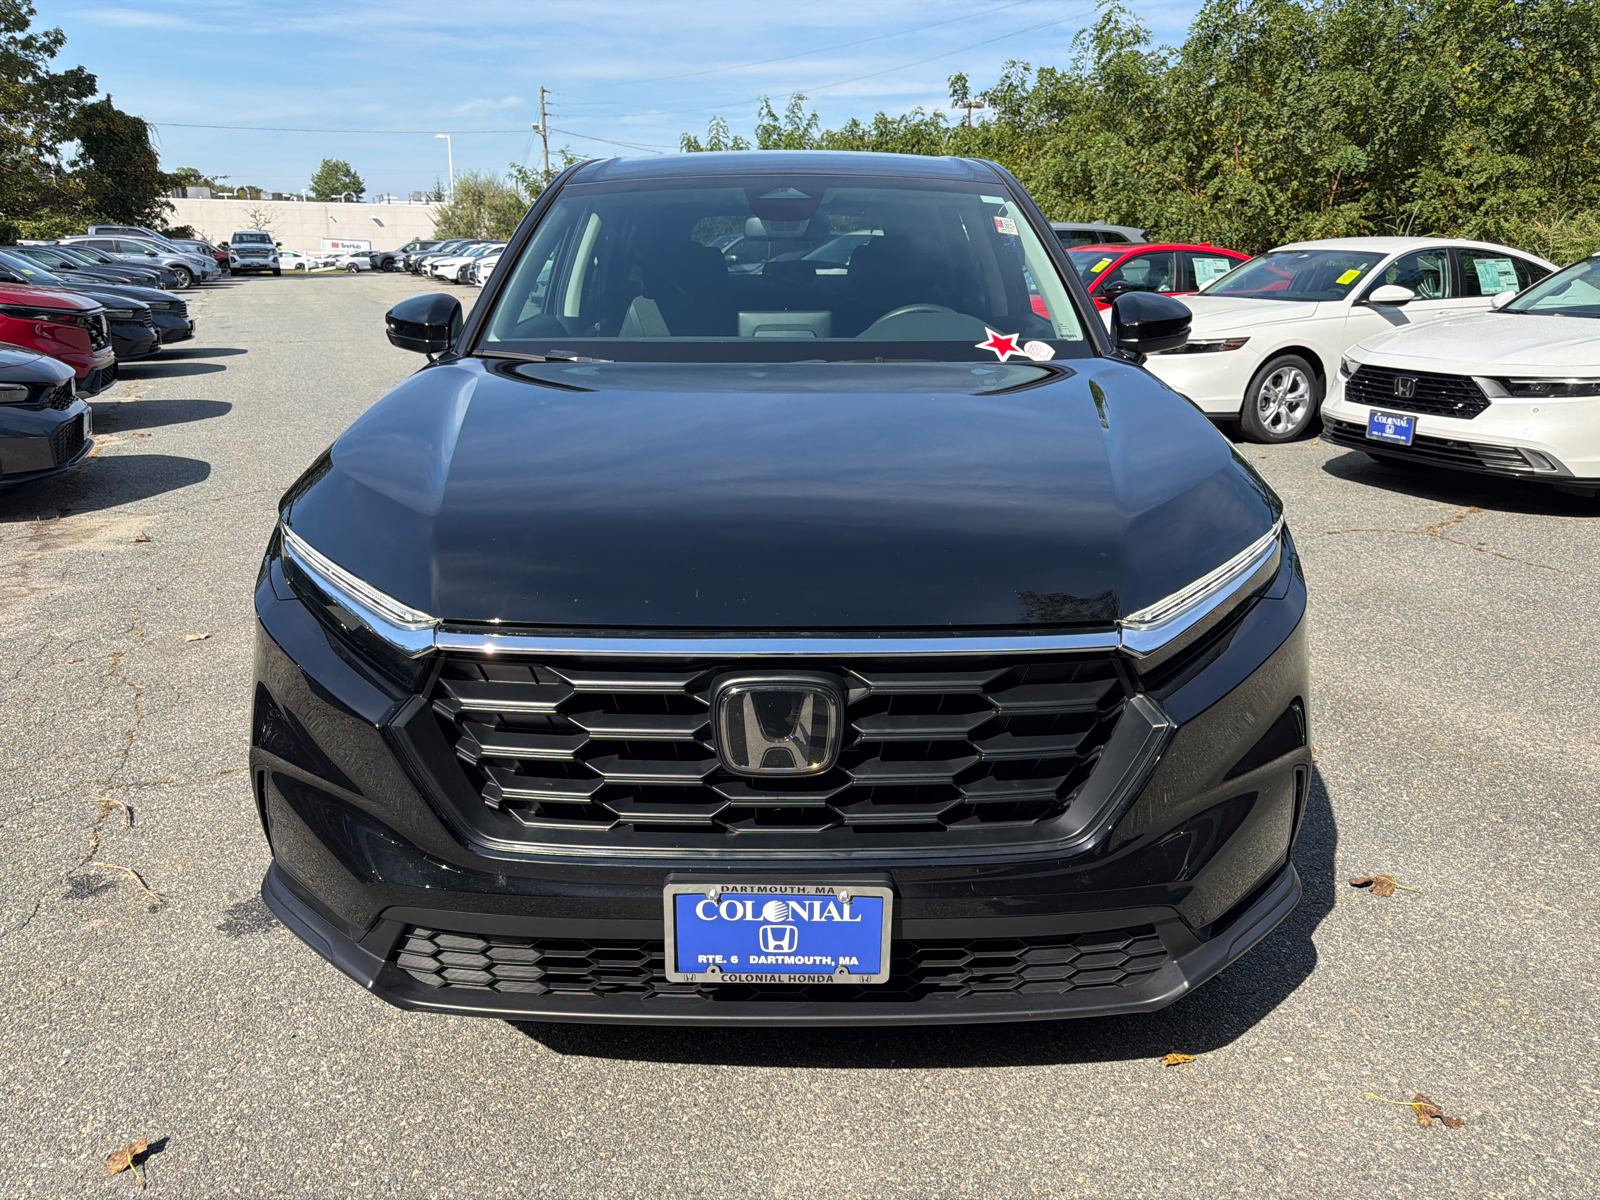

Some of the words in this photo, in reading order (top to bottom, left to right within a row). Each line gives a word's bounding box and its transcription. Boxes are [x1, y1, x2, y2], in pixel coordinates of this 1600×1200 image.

[815, 886, 835, 894] MA
[695, 899, 862, 922] COLONIAL
[698, 955, 727, 964] RTE.
[730, 955, 739, 964] 6
[749, 955, 836, 966] DARTMOUTH,
[838, 956, 859, 966] MA
[721, 974, 784, 983] COLONIAL
[788, 974, 834, 983] HONDA
